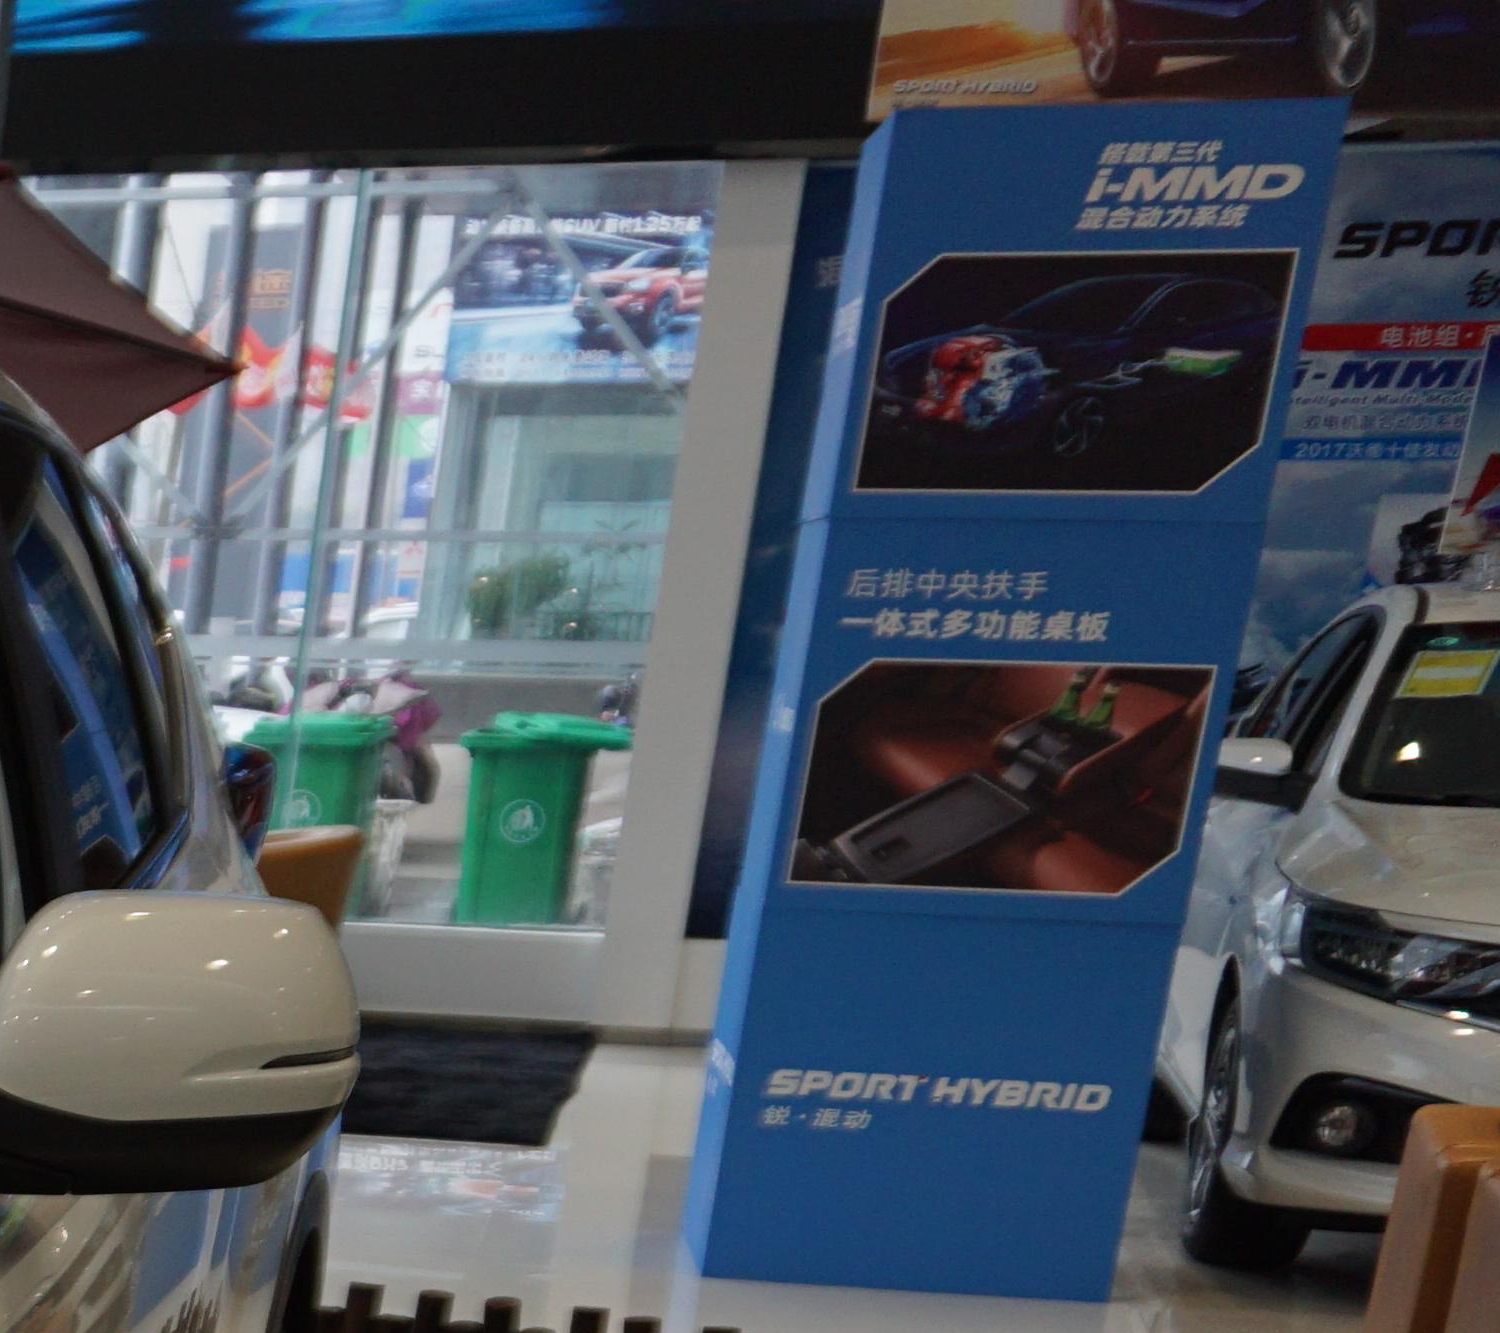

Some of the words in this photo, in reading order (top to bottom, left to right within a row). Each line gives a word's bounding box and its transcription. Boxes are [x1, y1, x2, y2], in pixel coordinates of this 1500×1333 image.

[1098, 140, 1224, 165] 搭载第三代
[1084, 164, 1306, 202] i-MMD
[1075, 204, 1250, 230] 混合动力系统
[846, 568, 1049, 600] 后排中央扶手
[840, 607, 1111, 642] 一体式多功能桌板
[766, 1069, 928, 1102] SPORT
[929, 1077, 1113, 1113] HYBRID
